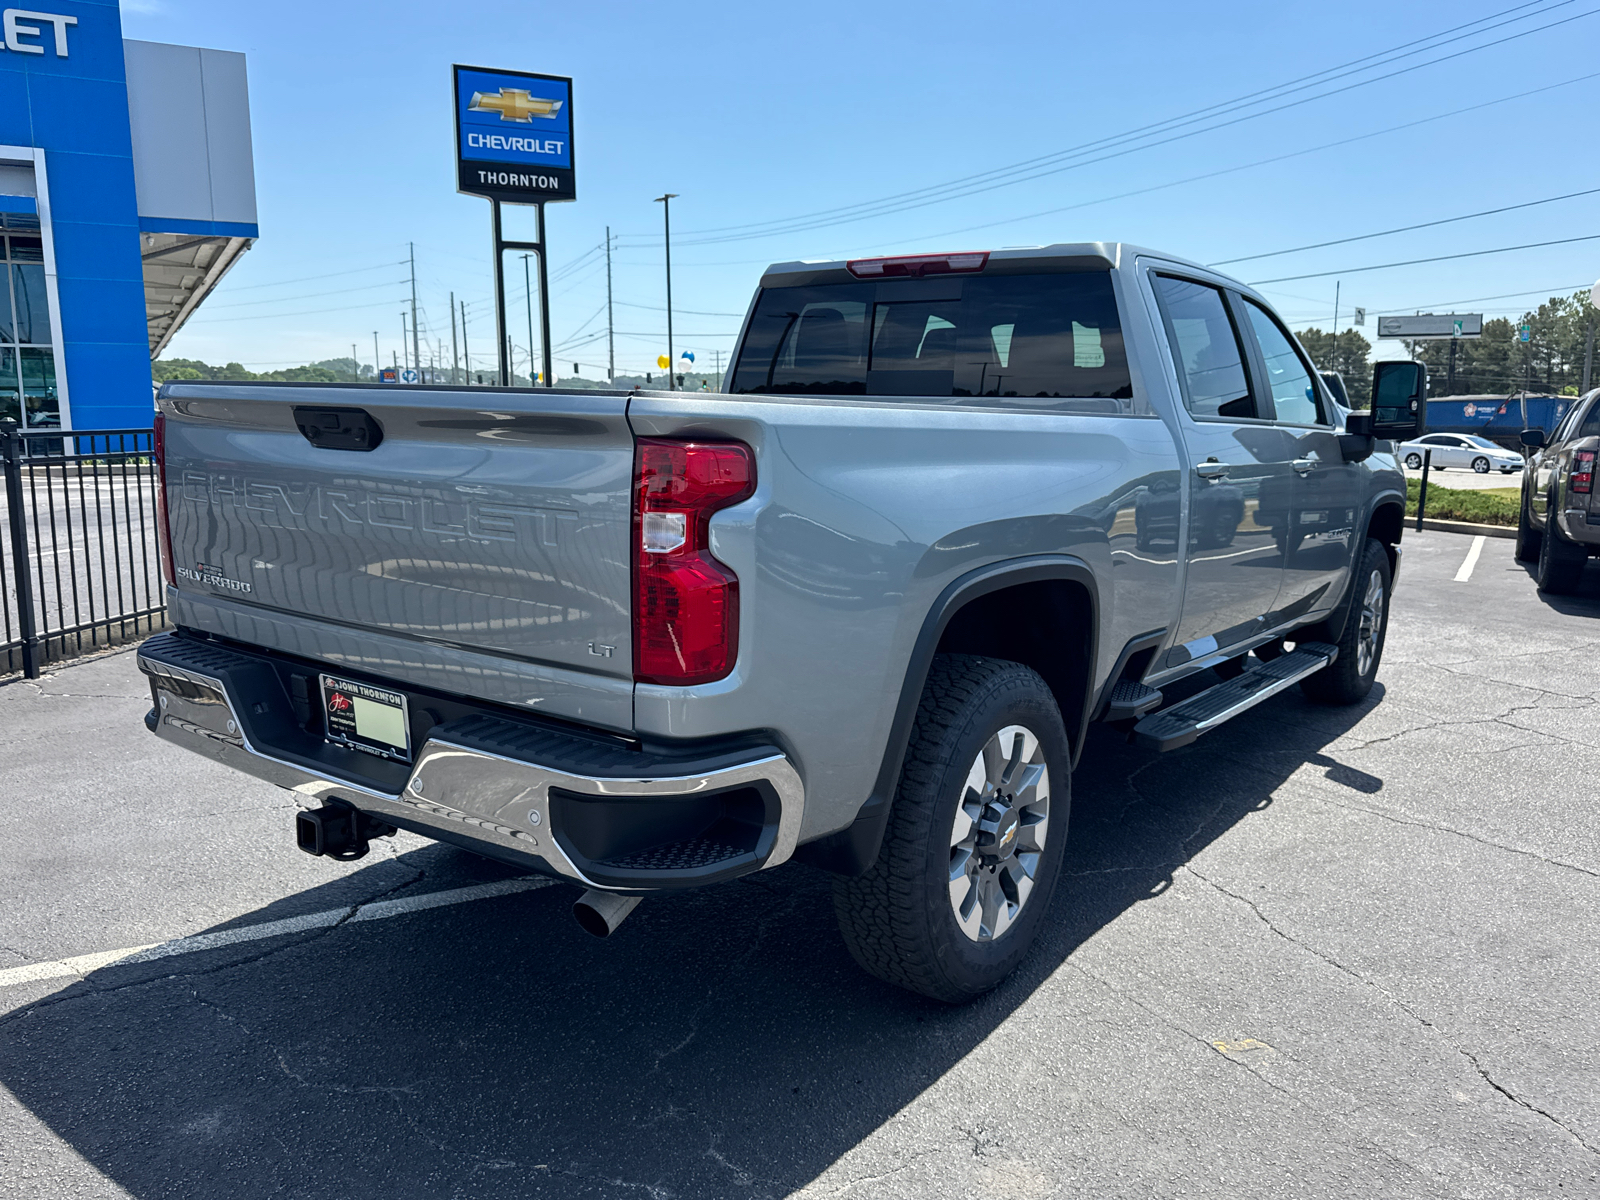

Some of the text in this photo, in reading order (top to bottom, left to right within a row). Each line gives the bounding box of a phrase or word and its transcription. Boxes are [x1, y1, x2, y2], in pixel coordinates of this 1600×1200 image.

[0, 8, 78, 57] ET
[468, 133, 564, 155] CHEVROLET
[478, 170, 559, 189] THORNTON
[182, 469, 579, 546] CHEVROLET
[177, 567, 252, 593] SILVERADO
[588, 641, 617, 658] LT
[339, 681, 401, 705] JOHN THORNTON
